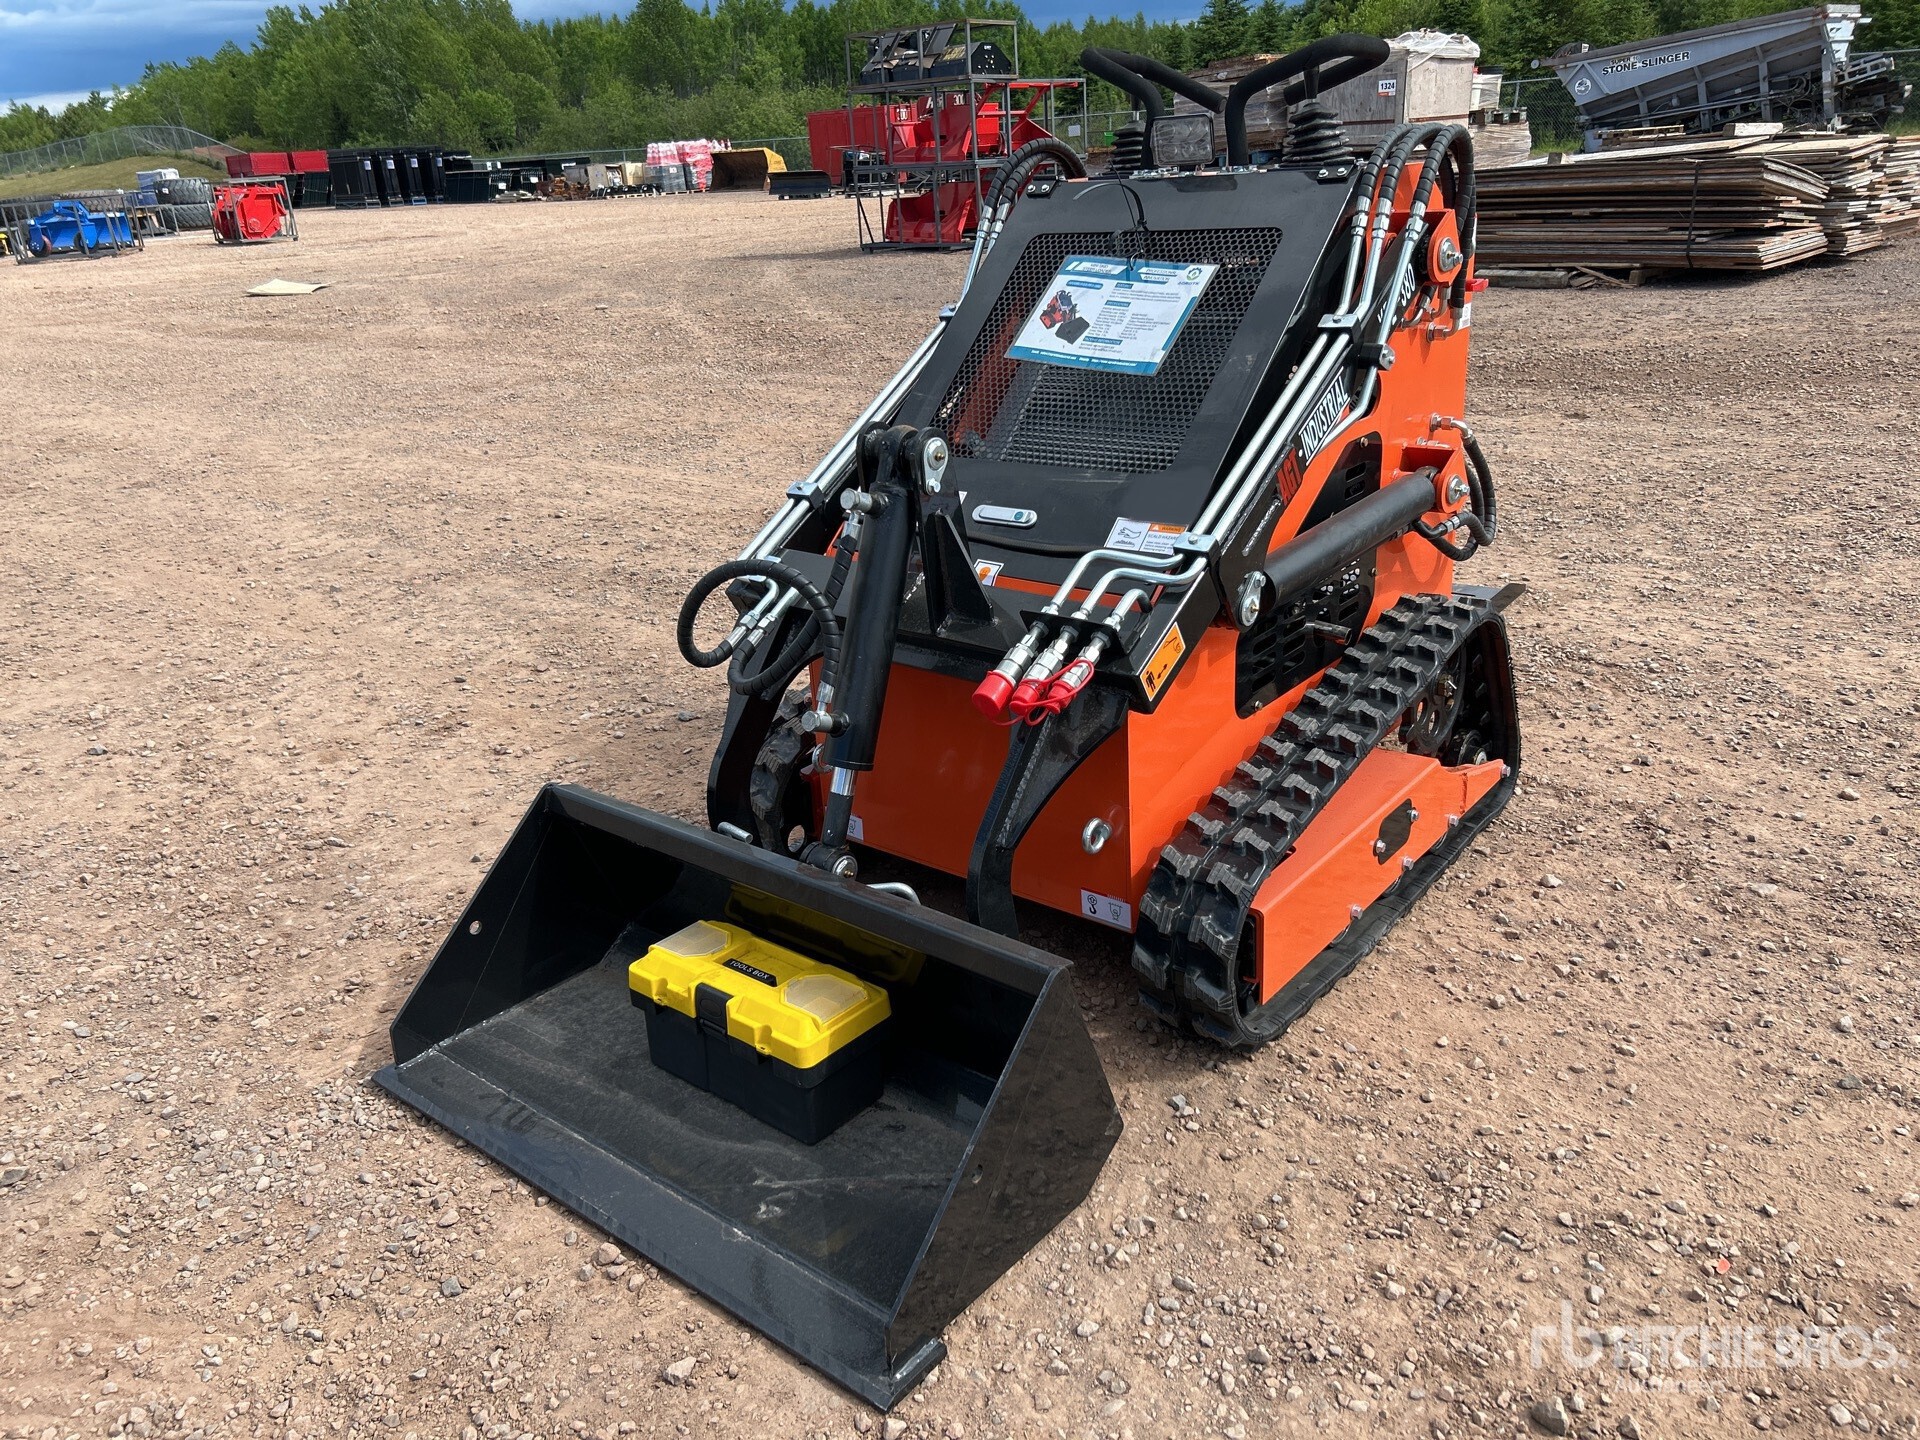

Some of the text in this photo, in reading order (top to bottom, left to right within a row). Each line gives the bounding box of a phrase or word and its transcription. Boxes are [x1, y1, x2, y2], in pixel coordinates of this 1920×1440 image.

[1602, 51, 1691, 76] STONE SLINGER
[1380, 82, 1395, 91] 1324
[1301, 376, 1348, 461] INDUSTRIAL
[730, 960, 770, 979] TOOLS BOX
